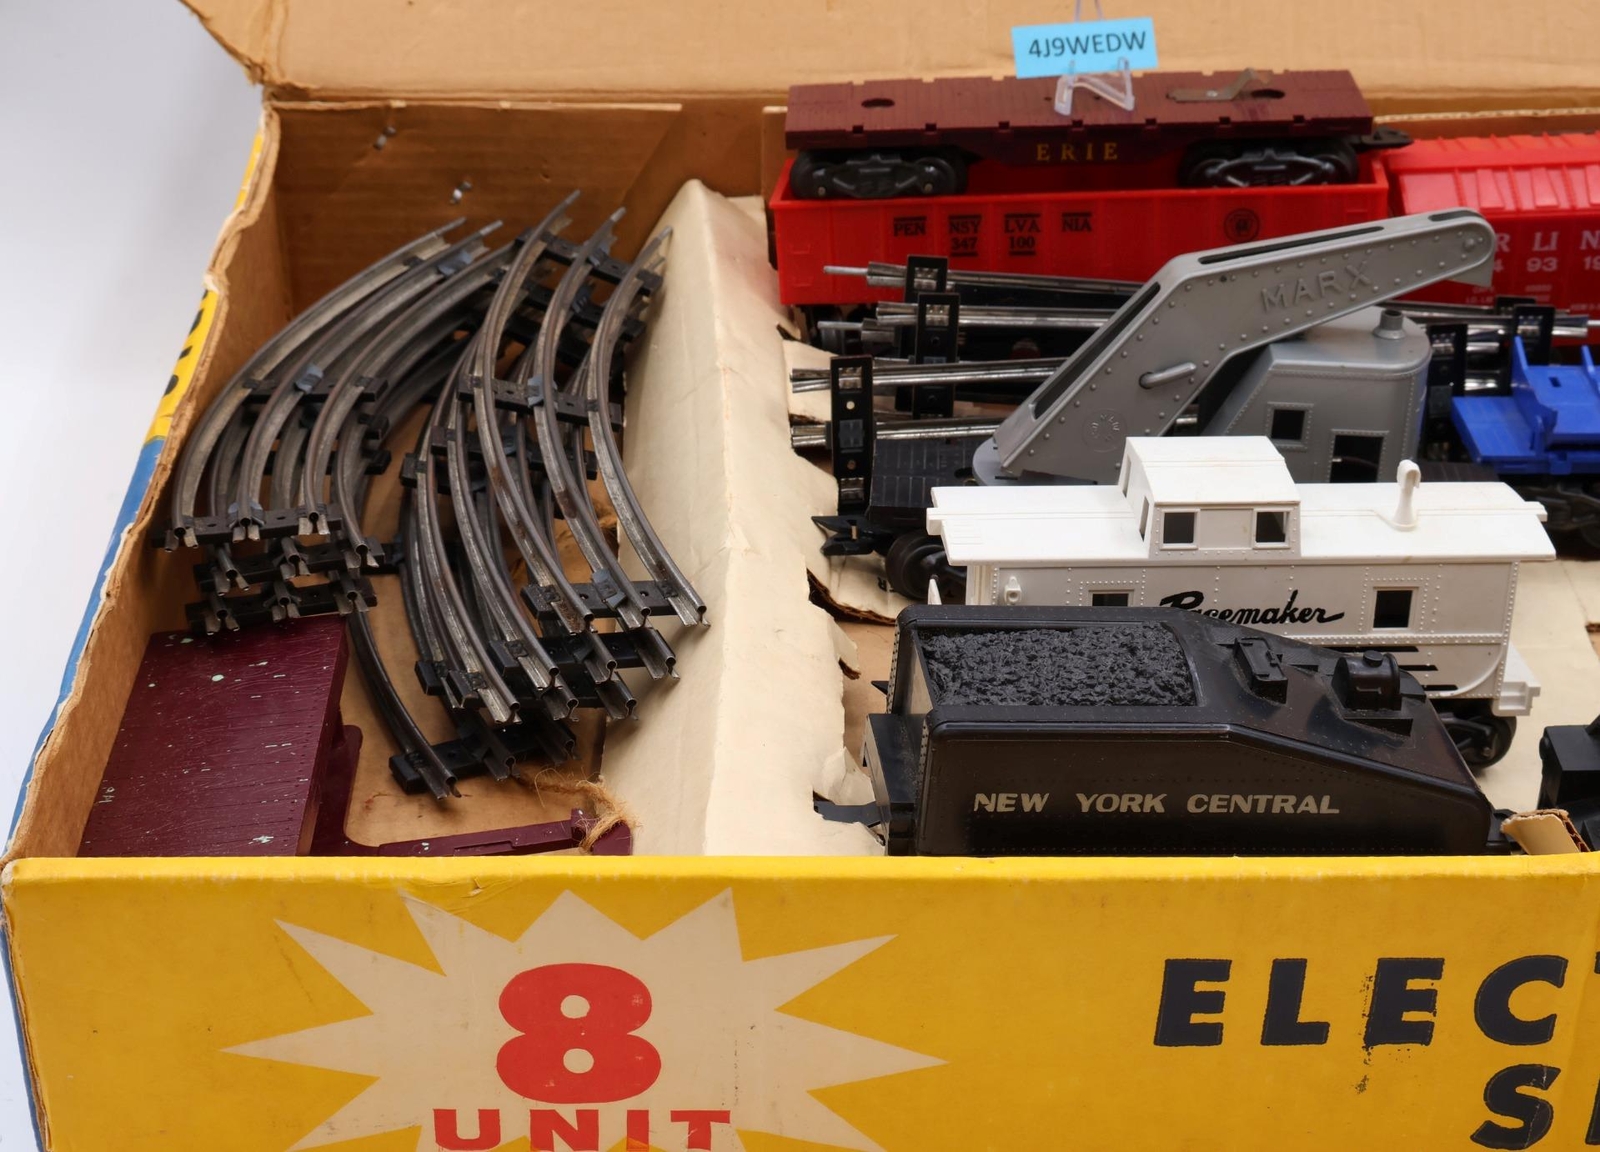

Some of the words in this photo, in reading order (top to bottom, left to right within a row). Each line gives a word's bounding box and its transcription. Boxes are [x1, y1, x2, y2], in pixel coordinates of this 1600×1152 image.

[1028, 31, 1147, 58] 4J9WEDW
[1036, 142, 1119, 161] ERIE
[893, 222, 926, 237] PEN
[949, 219, 982, 234] NSY
[1004, 218, 1041, 234] LVA
[1062, 217, 1092, 233] NIA
[951, 236, 978, 250] 347
[1008, 235, 1036, 250] 100
[1526, 256, 1558, 273] 93
[1261, 261, 1372, 313] MARX
[1159, 589, 1345, 624] Pcemaker
[973, 793, 1050, 813] NEW
[1076, 793, 1168, 813] YORK
[1186, 794, 1341, 814] CENTRAL
[1153, 953, 1600, 1047] ELEC
[496, 963, 662, 1104] 8
[432, 1108, 731, 1152] UNIT
